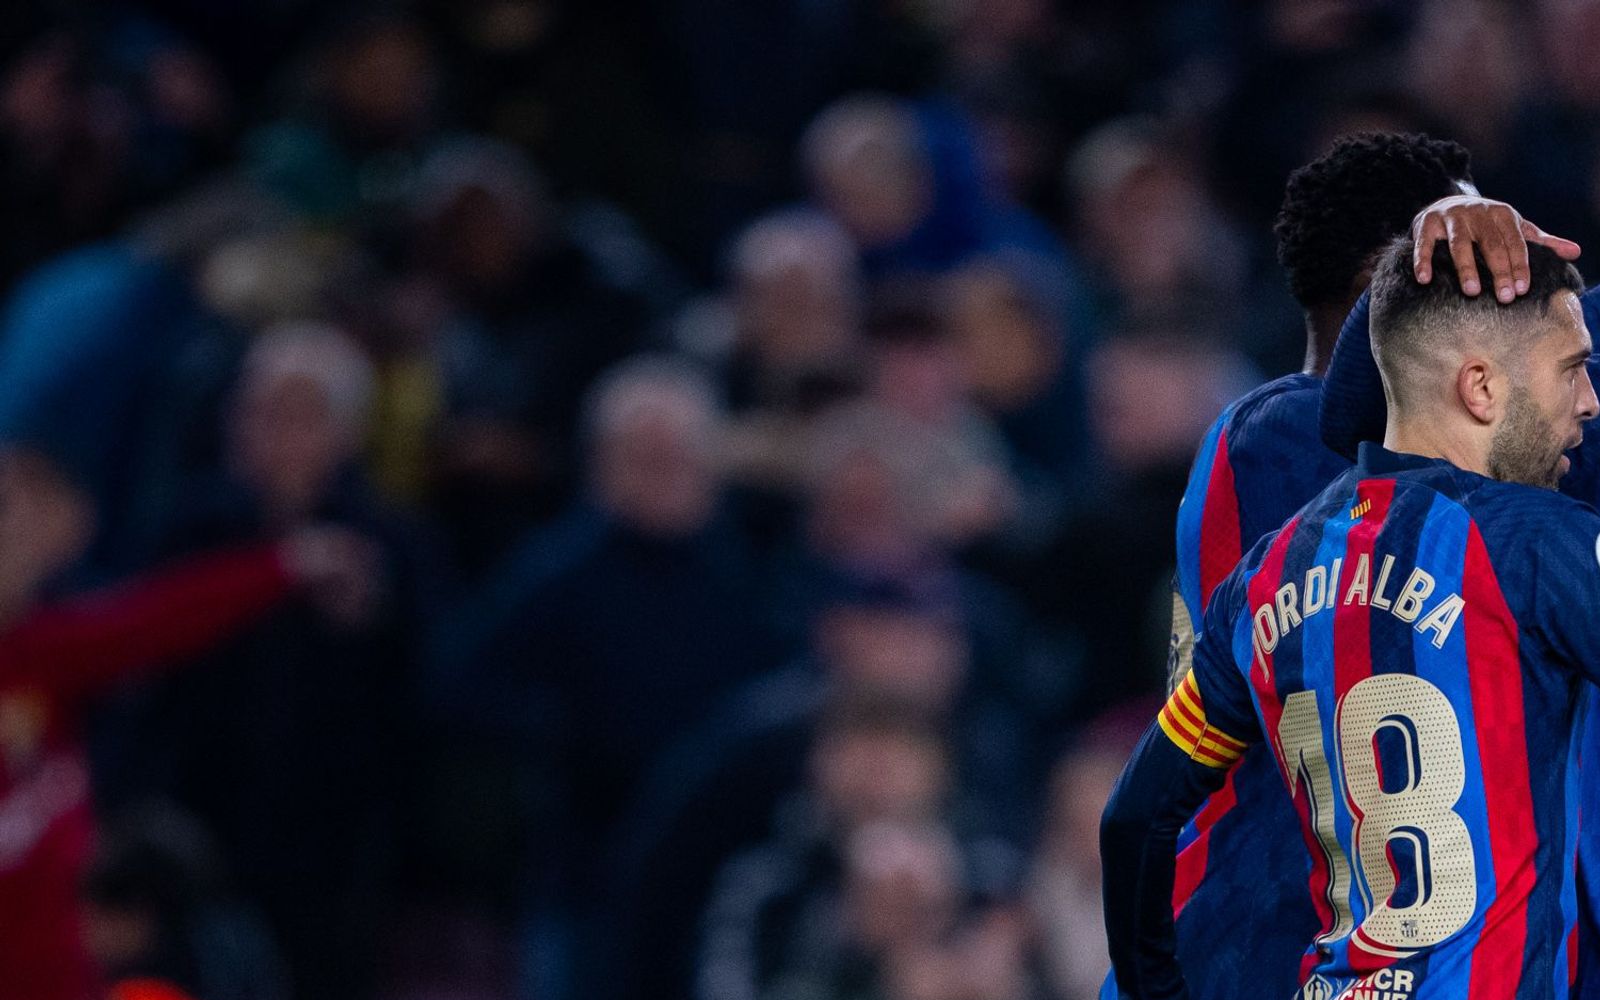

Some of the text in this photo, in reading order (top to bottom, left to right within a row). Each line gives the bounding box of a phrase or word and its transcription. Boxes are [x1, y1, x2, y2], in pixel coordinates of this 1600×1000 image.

[1252, 557, 1343, 683] JORDI
[1344, 553, 1466, 649] ALBA
[1275, 673, 1477, 959] 18
